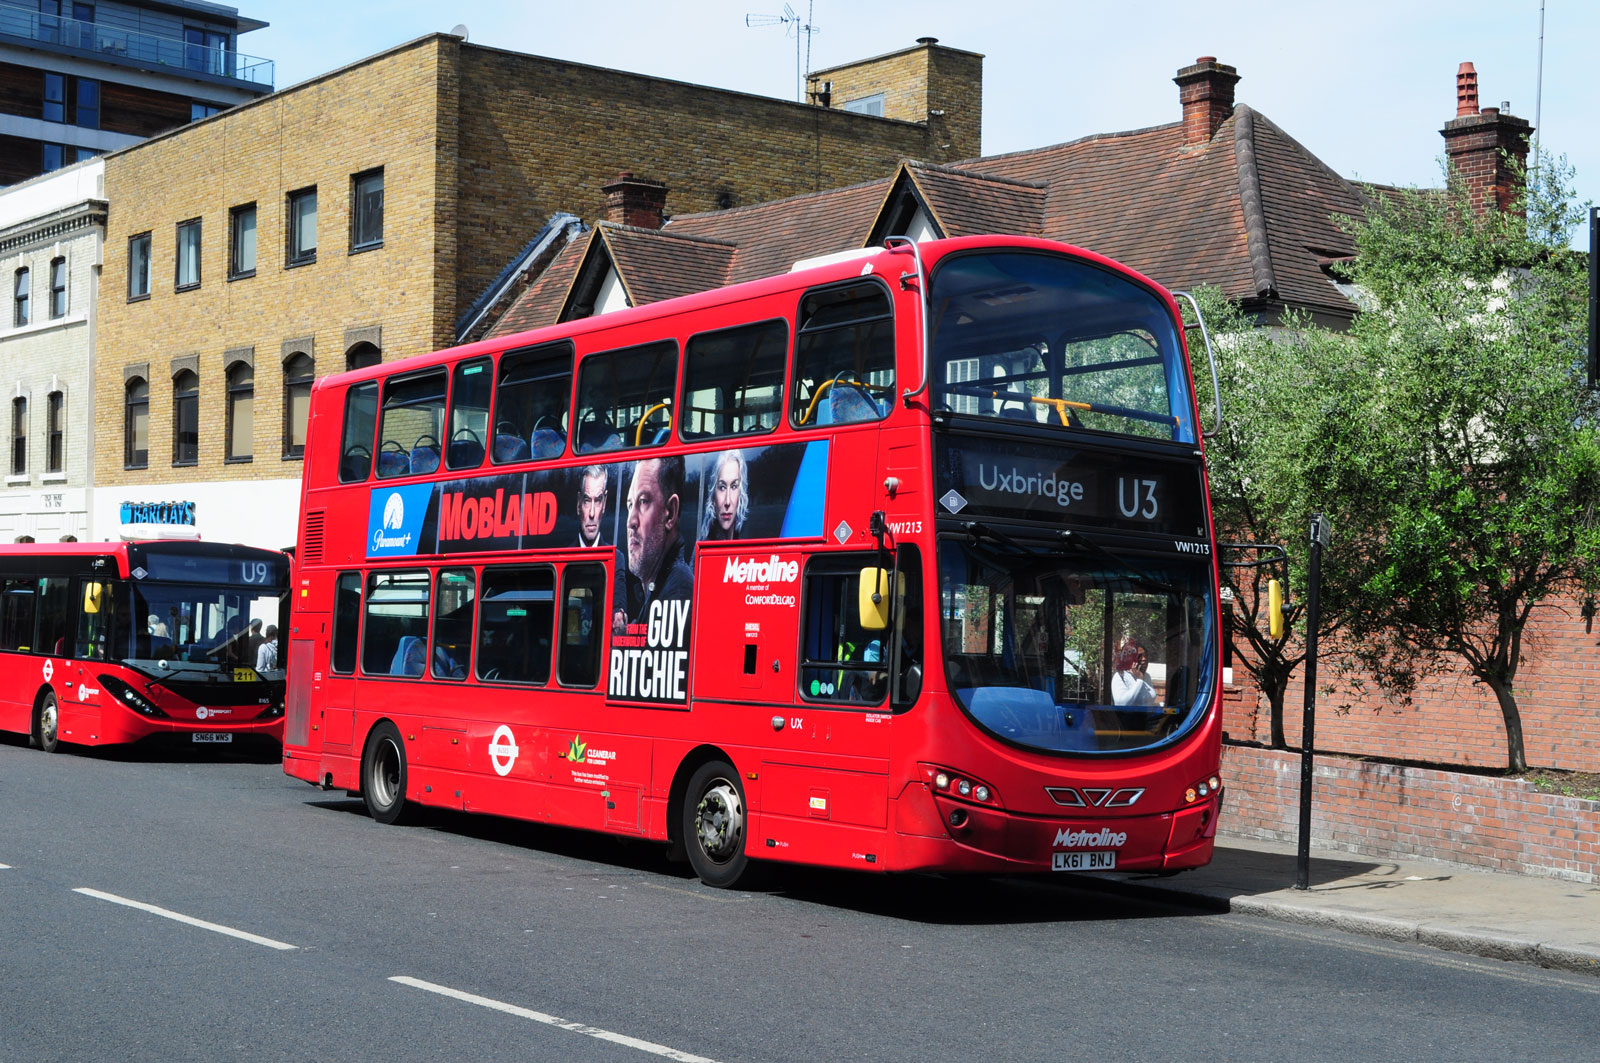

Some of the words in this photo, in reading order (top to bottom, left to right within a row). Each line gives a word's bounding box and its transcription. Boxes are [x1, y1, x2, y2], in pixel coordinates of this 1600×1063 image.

[979, 464, 1083, 507] Uxbridge
[1119, 477, 1158, 519] U3
[134, 502, 194, 525] BARCLAYS
[439, 488, 558, 541] MOBLAND
[887, 521, 922, 534] VW1213
[1175, 541, 1210, 554] VW1213
[242, 562, 267, 583] U9
[723, 555, 799, 583] Metroline
[647, 599, 691, 648] GUY
[238, 672, 253, 680] 211
[609, 649, 688, 699] RITCHIE
[791, 717, 803, 729] UX
[1052, 828, 1127, 847] Metroline
[1054, 854, 1083, 868] LK61
[1090, 853, 1112, 867] BNJ
